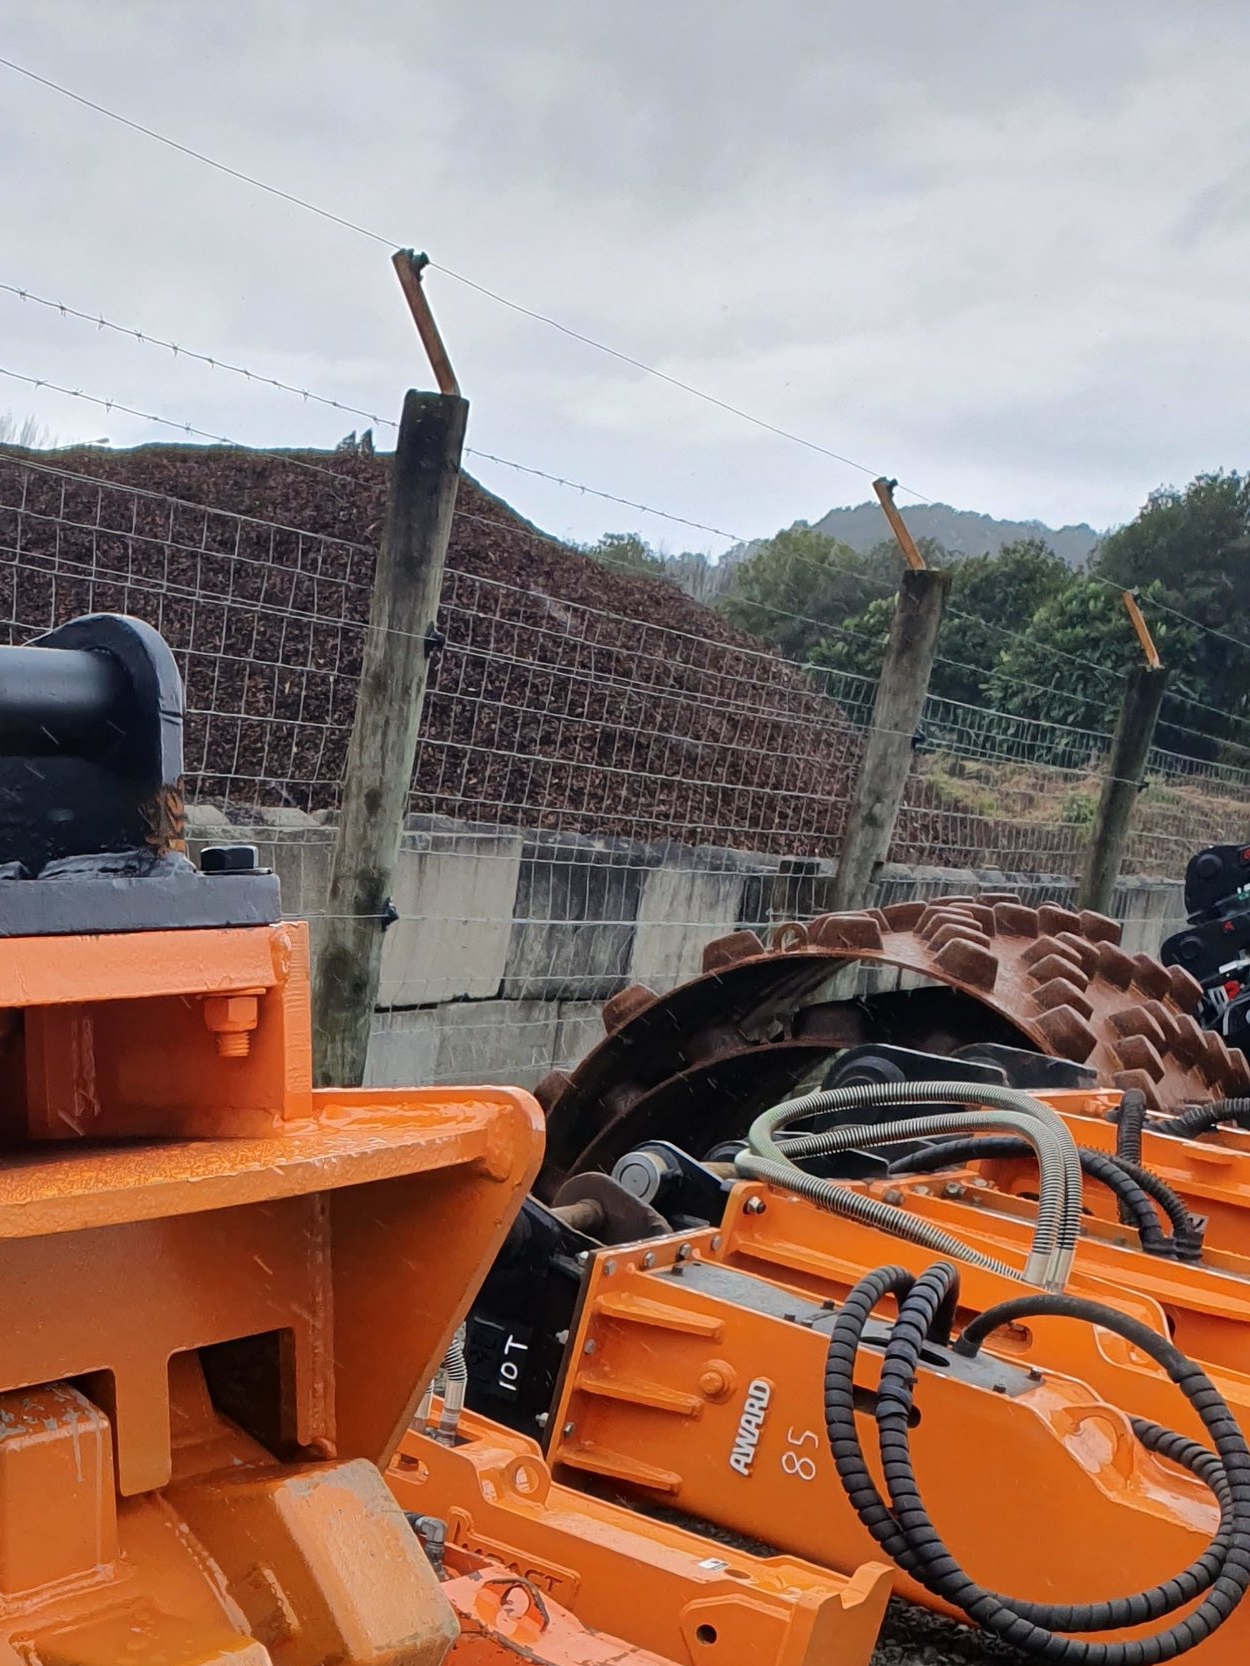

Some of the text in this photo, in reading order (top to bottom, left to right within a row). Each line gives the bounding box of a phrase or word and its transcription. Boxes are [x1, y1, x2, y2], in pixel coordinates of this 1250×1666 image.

[496, 1333, 529, 1391] 10T
[729, 1379, 772, 1477] AWARD
[781, 1425, 820, 1480] 85
